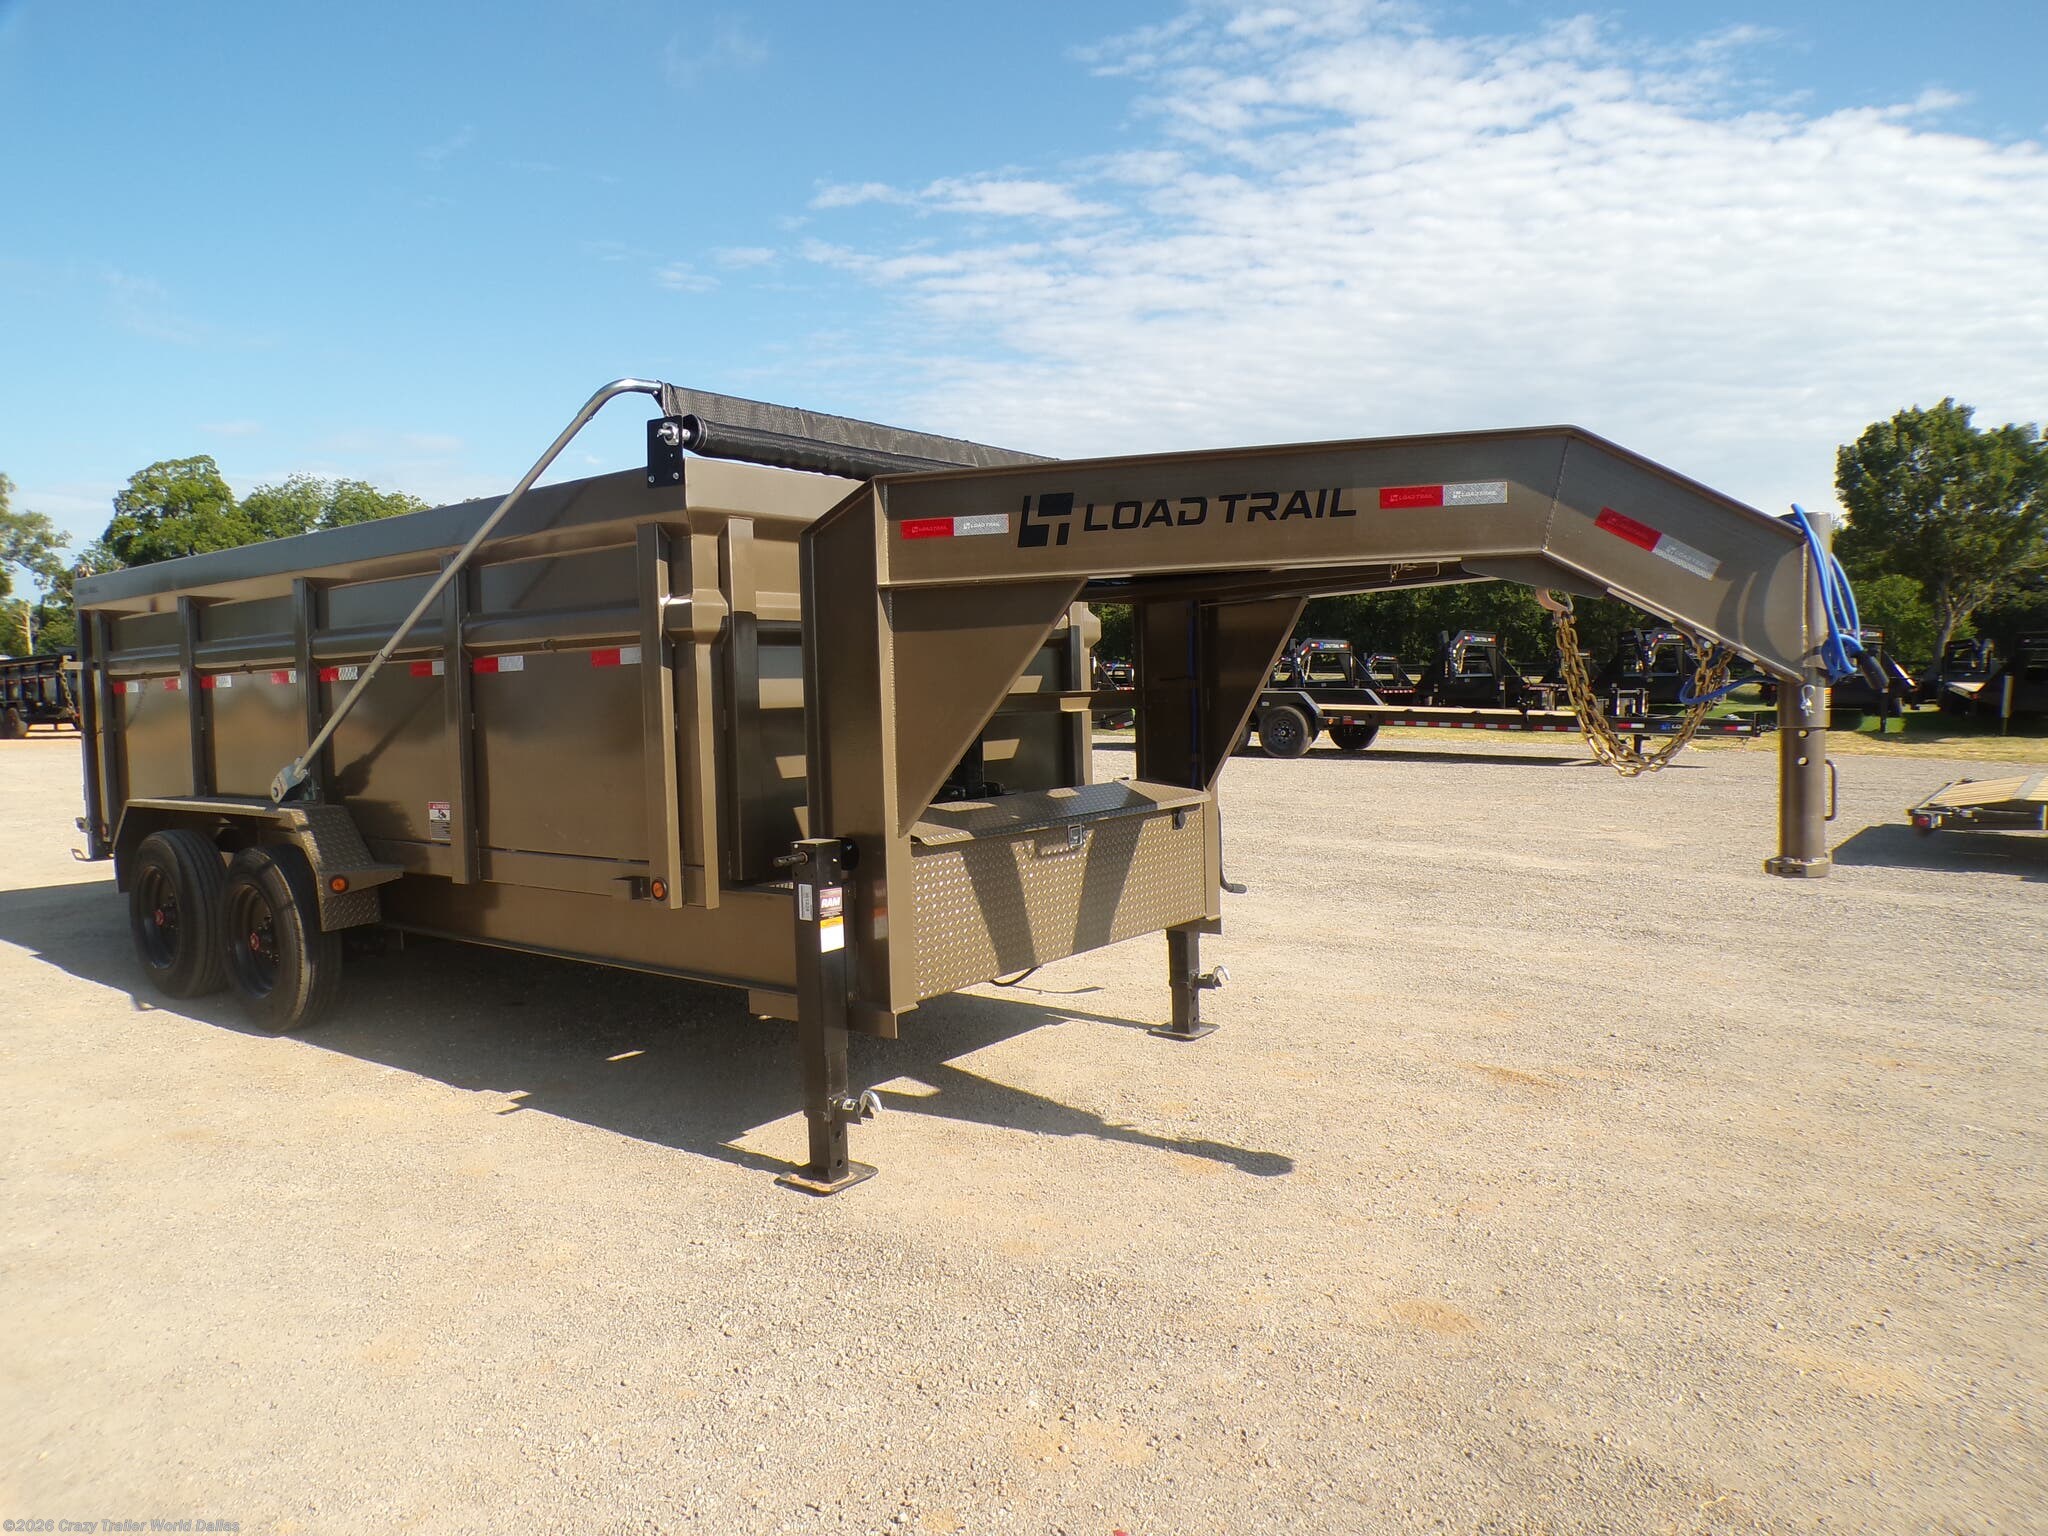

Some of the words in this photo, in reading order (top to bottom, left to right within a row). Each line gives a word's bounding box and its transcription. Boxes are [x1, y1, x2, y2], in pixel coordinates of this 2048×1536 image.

[1083, 496, 1209, 532] LOAD
[1218, 487, 1357, 523] TRAIL
[821, 897, 841, 908] RAM
